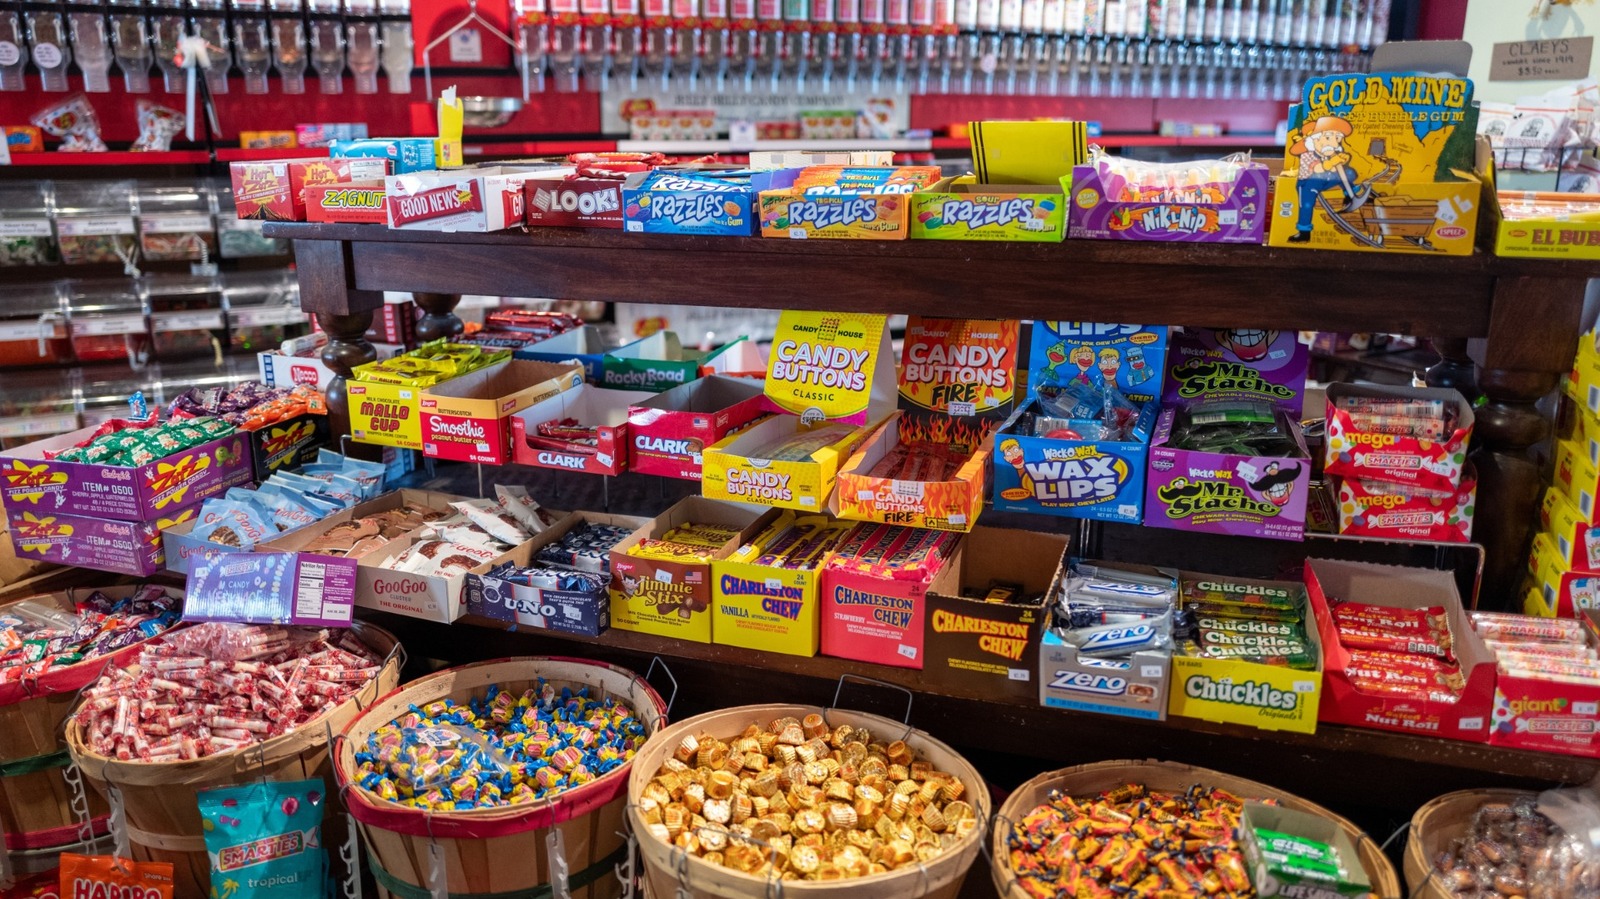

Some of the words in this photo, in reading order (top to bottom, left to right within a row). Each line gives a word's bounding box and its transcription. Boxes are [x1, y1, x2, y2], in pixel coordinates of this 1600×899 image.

[1509, 39, 1569, 57] CLAEYS
[1309, 77, 1384, 110] GOLD
[1390, 76, 1467, 108] MINE
[1430, 111, 1465, 122] GUM
[322, 189, 386, 208] ZAGNUT
[401, 195, 429, 218] GOOD
[430, 190, 461, 212] NEWS
[512, 196, 523, 216] GO
[550, 187, 620, 216] LOOK!
[727, 216, 743, 227] Gum
[1531, 229, 1555, 245] EL
[1558, 229, 1600, 247] BUB
[792, 324, 819, 334] CANDY
[837, 330, 864, 339] HOUSE
[922, 330, 950, 338] CANDY
[970, 332, 999, 340] HOUSE
[1111, 337, 1128, 345] LATER
[778, 340, 869, 371] CANDY
[908, 342, 1008, 368] CANDY
[605, 369, 646, 385] Rocky
[646, 368, 685, 382] Road
[772, 362, 866, 391] BUTTONS
[905, 364, 1007, 387] BUTTONS
[1217, 362, 1260, 378] Mr.
[792, 388, 835, 402] CLASSIC
[931, 382, 978, 406] FIRE
[1180, 377, 1293, 398] Stache
[360, 401, 410, 420] MALLO
[438, 408, 472, 416] BUTTERSCOTCH
[370, 416, 400, 432] CUP
[429, 416, 486, 438] Smoothie
[431, 434, 452, 442] peanut
[454, 435, 472, 444] butter
[635, 435, 689, 455] CLARK
[1344, 432, 1395, 448] mega
[477, 455, 496, 463] COUNT
[538, 452, 586, 469] CLARK
[1367, 456, 1418, 467] SMARTIES
[1025, 456, 1116, 481] WAX
[1384, 468, 1418, 479] original
[726, 468, 792, 489] CANDY
[82, 482, 110, 492] ITEM#
[112, 484, 134, 496] 0500
[727, 482, 792, 501] BUTTONS
[1035, 477, 1118, 500] LIPS
[1202, 482, 1244, 498] Mr.
[746, 496, 774, 506] CLASSIC
[876, 492, 925, 505] CANDY
[1096, 494, 1116, 504] LATER
[1168, 497, 1276, 516] Stache
[1356, 494, 1406, 510] mega
[875, 502, 926, 514] BUTTONS
[884, 512, 915, 523] FIRE
[1380, 515, 1430, 526] SMARTIES
[1398, 527, 1431, 536] original
[112, 540, 133, 551] 0500
[228, 580, 250, 588] CANDY
[634, 576, 693, 597] Jimmie
[720, 574, 803, 600] CHARLESTON
[390, 594, 412, 602] CLUSTER
[644, 590, 684, 607] Stix
[834, 586, 913, 610] CHARLESTON
[379, 600, 391, 608] THE
[392, 602, 424, 614] ORIGINAL
[720, 604, 749, 618] VANILLA
[762, 597, 804, 622] CHEW
[1022, 610, 1033, 618] 24
[624, 618, 640, 626] COUNT
[834, 612, 866, 624] STRAWBERRY
[874, 608, 914, 629] CHEW
[932, 608, 1029, 640] CHARLESTON
[1018, 616, 1036, 624] COUNT
[1088, 624, 1150, 643] Zero
[1340, 628, 1379, 638] Nut
[1502, 626, 1561, 636] SMARTIES
[978, 634, 1029, 661] CHEW
[1049, 670, 1127, 692] Zero
[1509, 696, 1562, 715] giant
[1258, 708, 1298, 721] Originals
[1365, 712, 1399, 726] Nut
[1402, 720, 1440, 731] Roll
[1530, 720, 1591, 732] SMARTIES
[1552, 733, 1592, 745] original
[222, 836, 300, 866] SMARTIES
[74, 878, 162, 899] HARIBO
[247, 872, 299, 889] tropical
[1279, 884, 1305, 899] LIFE
